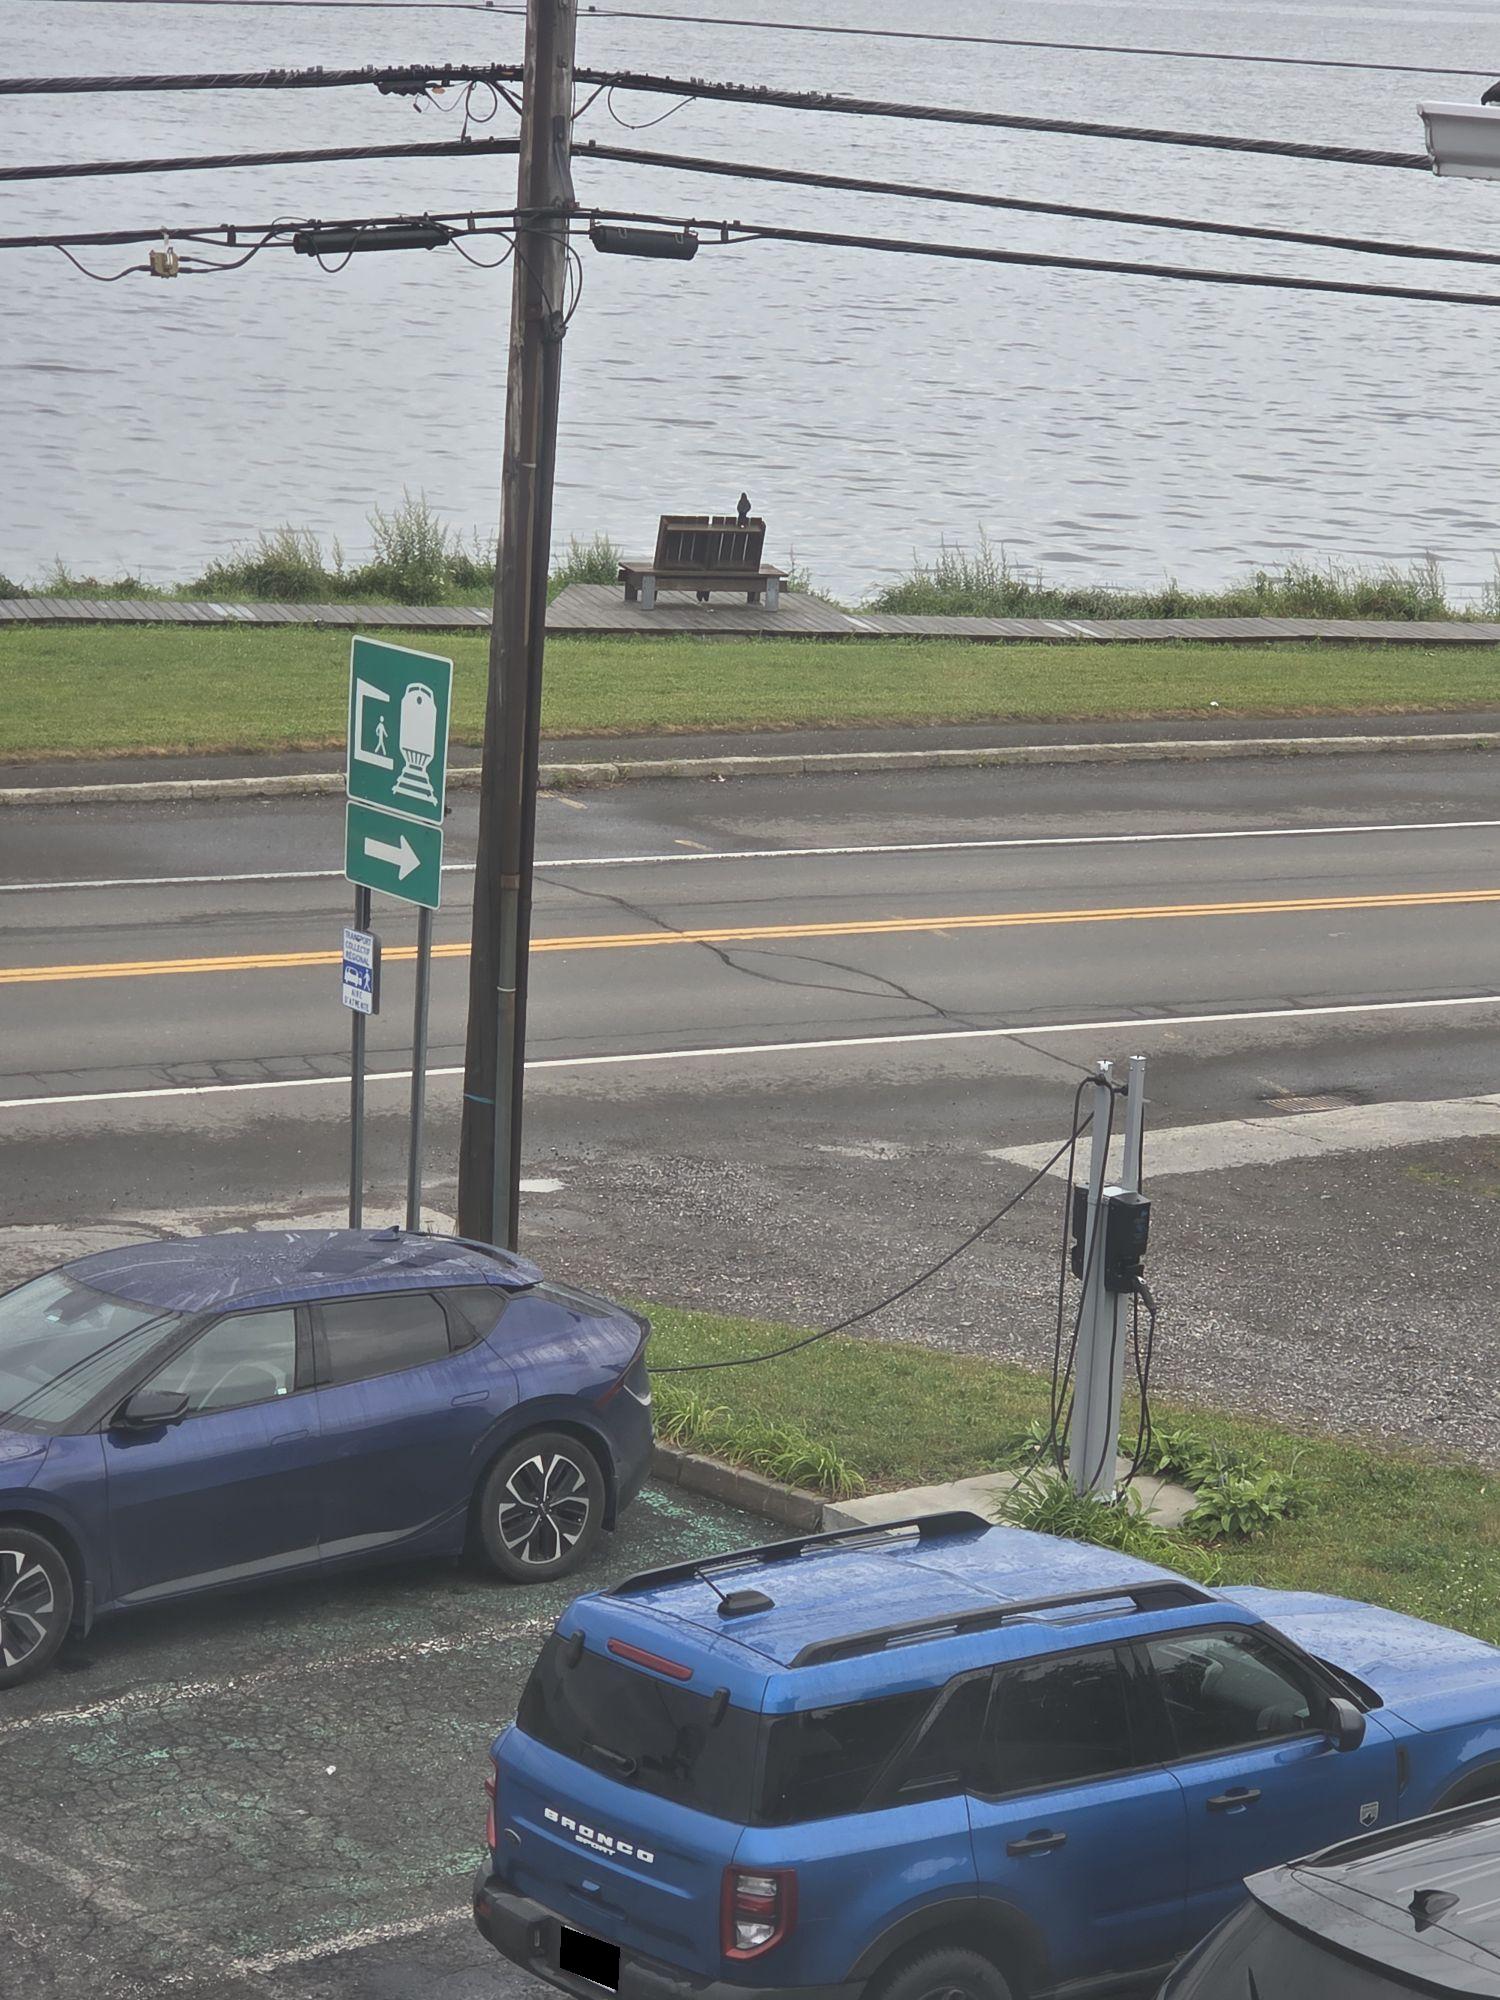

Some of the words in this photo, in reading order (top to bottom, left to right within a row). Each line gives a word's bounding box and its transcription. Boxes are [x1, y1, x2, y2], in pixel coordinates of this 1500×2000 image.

[345, 930, 371, 946] TRANSPORT
[544, 1807, 655, 1864] BRONCO
[575, 1834, 616, 1856] SPORT
